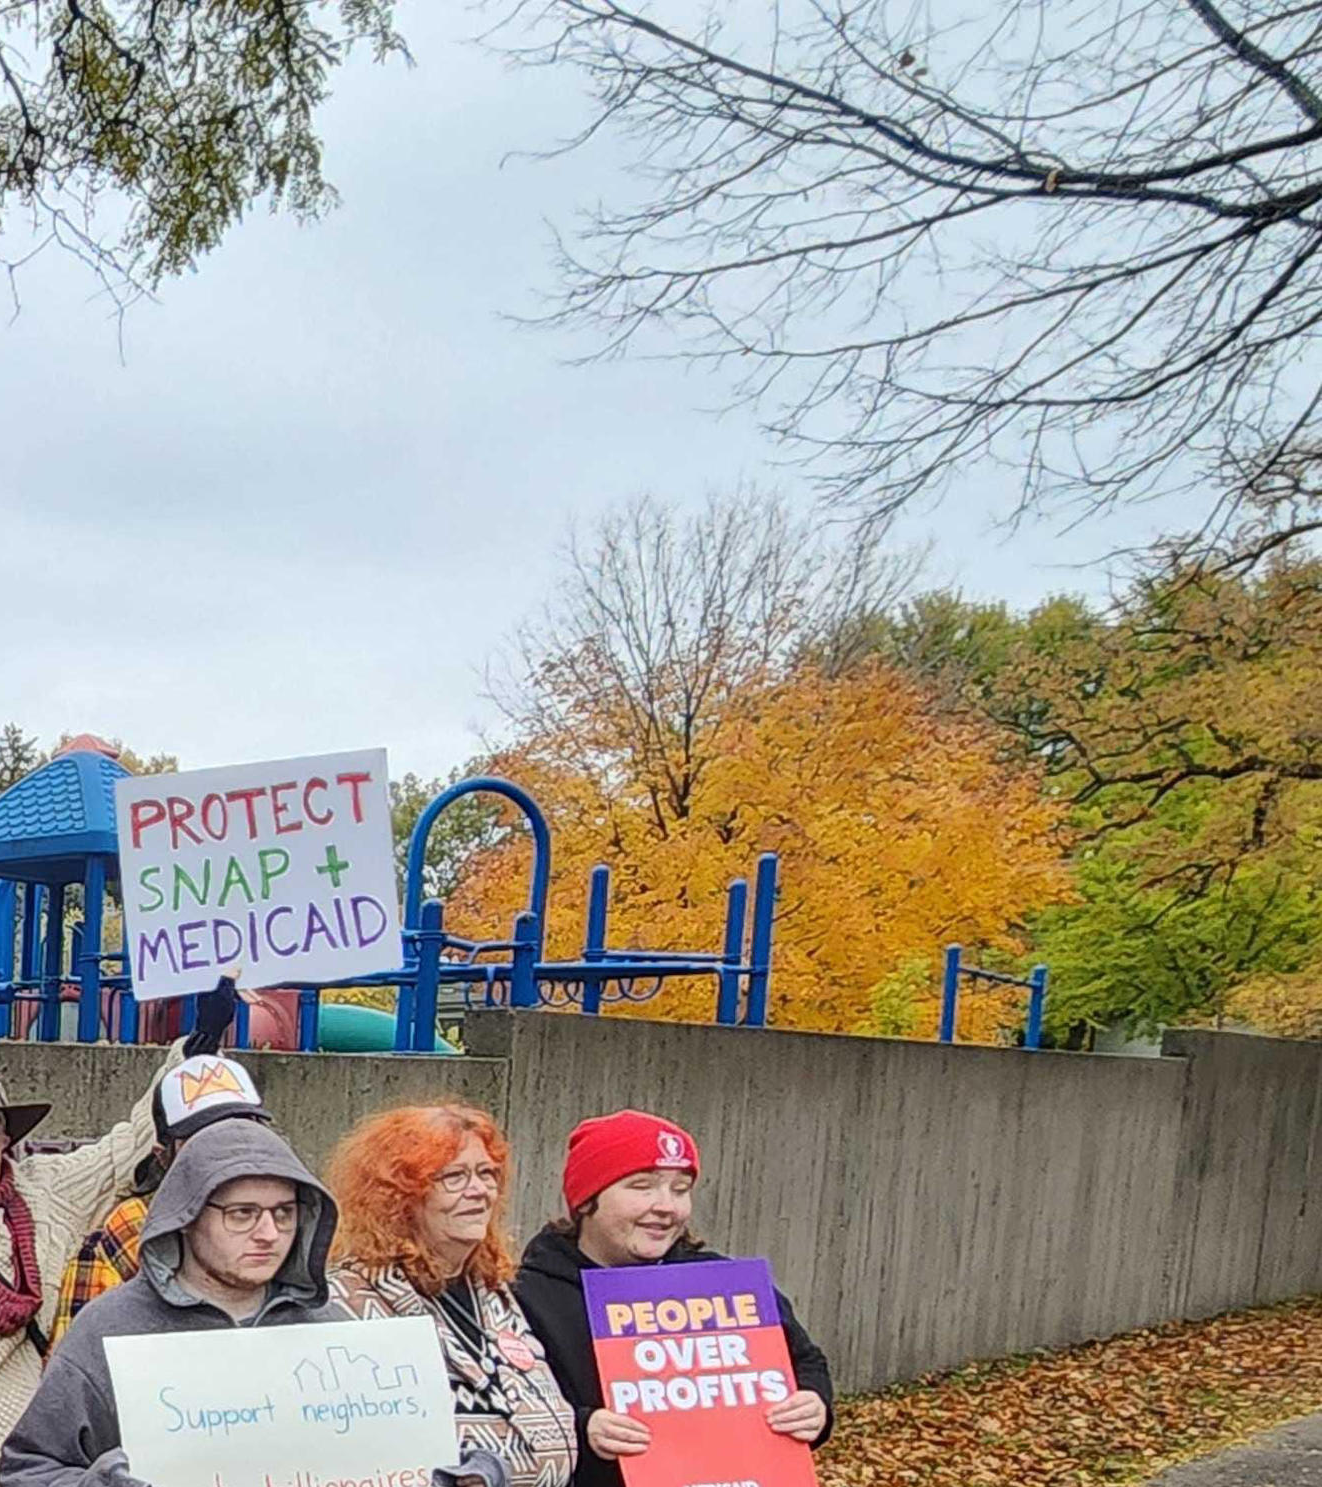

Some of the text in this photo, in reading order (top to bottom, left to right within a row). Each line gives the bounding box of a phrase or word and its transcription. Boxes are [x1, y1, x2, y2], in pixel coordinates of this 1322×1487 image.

[130, 771, 373, 850] PROTECT
[138, 848, 290, 912] SNAP
[137, 895, 388, 982] MEDICAID
[605, 1293, 761, 1336] PEOPLE
[633, 1334, 751, 1372] OVER
[159, 1386, 428, 1436] Support neighbors,
[609, 1369, 789, 1415] PROFITS
